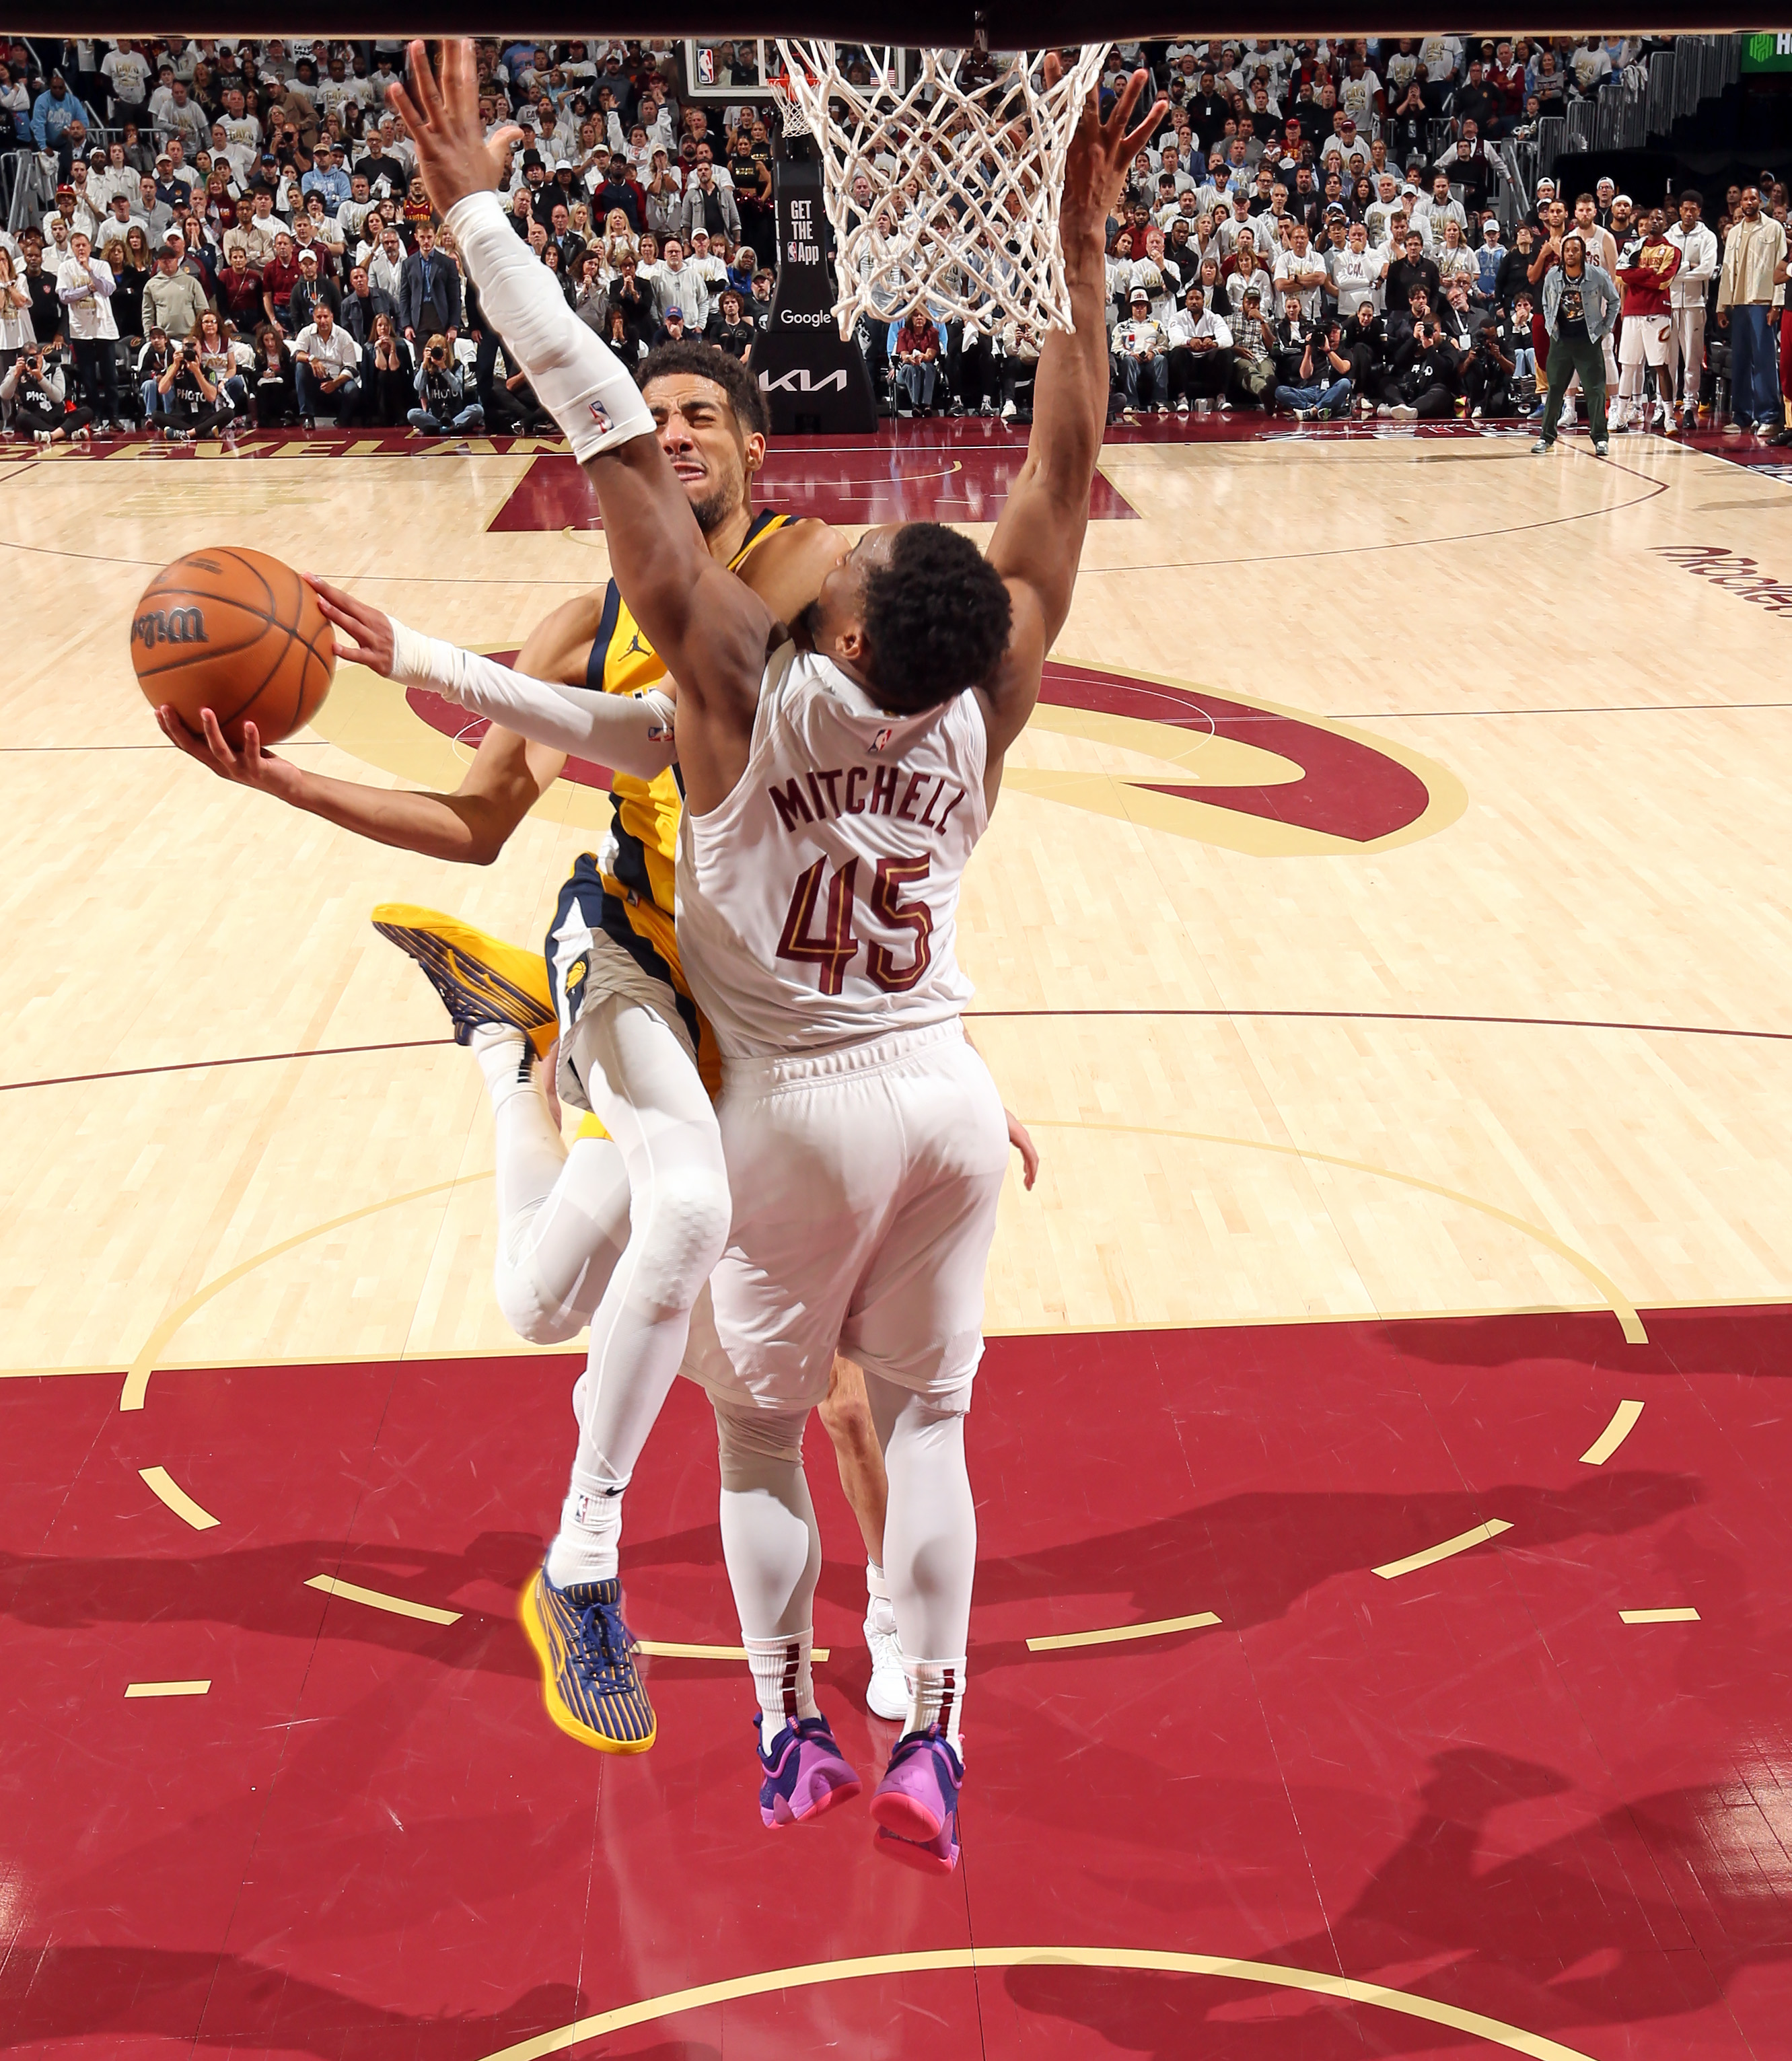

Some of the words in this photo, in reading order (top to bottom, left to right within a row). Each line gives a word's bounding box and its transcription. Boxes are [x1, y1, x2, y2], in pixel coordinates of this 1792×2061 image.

[791, 200, 812, 219] GET
[791, 221, 814, 240] THE
[798, 242, 820, 265] App
[781, 309, 832, 328] Google
[758, 369, 847, 392] KIA
[26, 390, 47, 402] PHO
[768, 764, 965, 836] MITCHELL
[775, 852, 933, 996] 45
